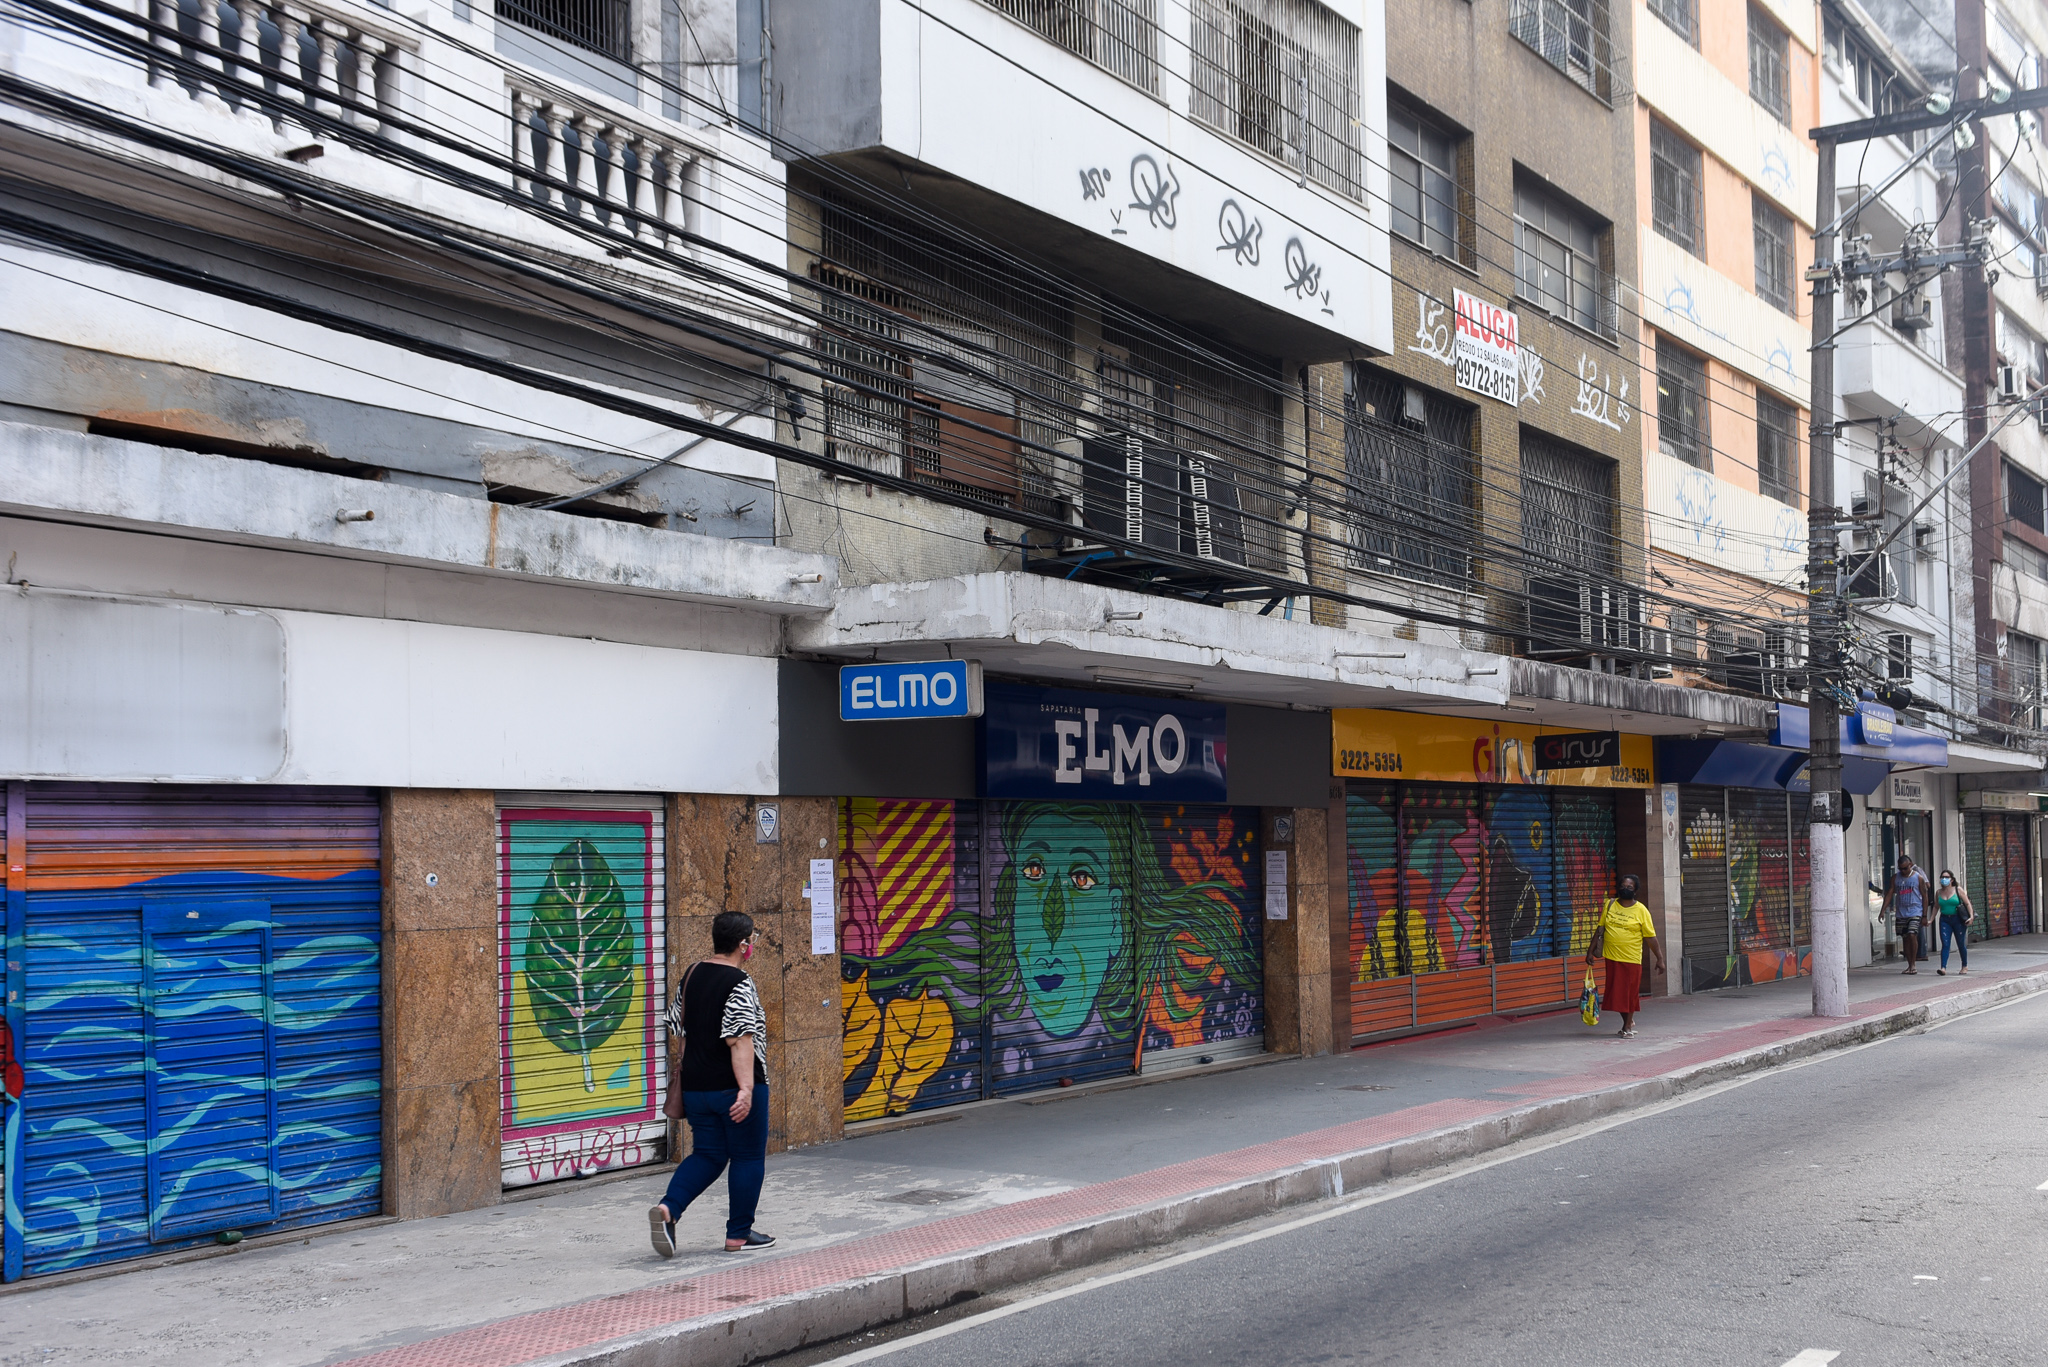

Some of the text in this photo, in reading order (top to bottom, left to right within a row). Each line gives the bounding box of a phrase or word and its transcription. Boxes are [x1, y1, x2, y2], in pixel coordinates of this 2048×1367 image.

[1455, 293, 1517, 356] ALUGA
[1456, 356, 1516, 402] 99722-8157
[851, 671, 958, 710] ELMO
[1040, 703, 1082, 715] SAPATARIA
[1055, 707, 1186, 786] ELMO
[1340, 749, 1403, 773] 3223-5354
[1473, 723, 1549, 785] Giru
[1610, 766, 1650, 783] 3223-5354
